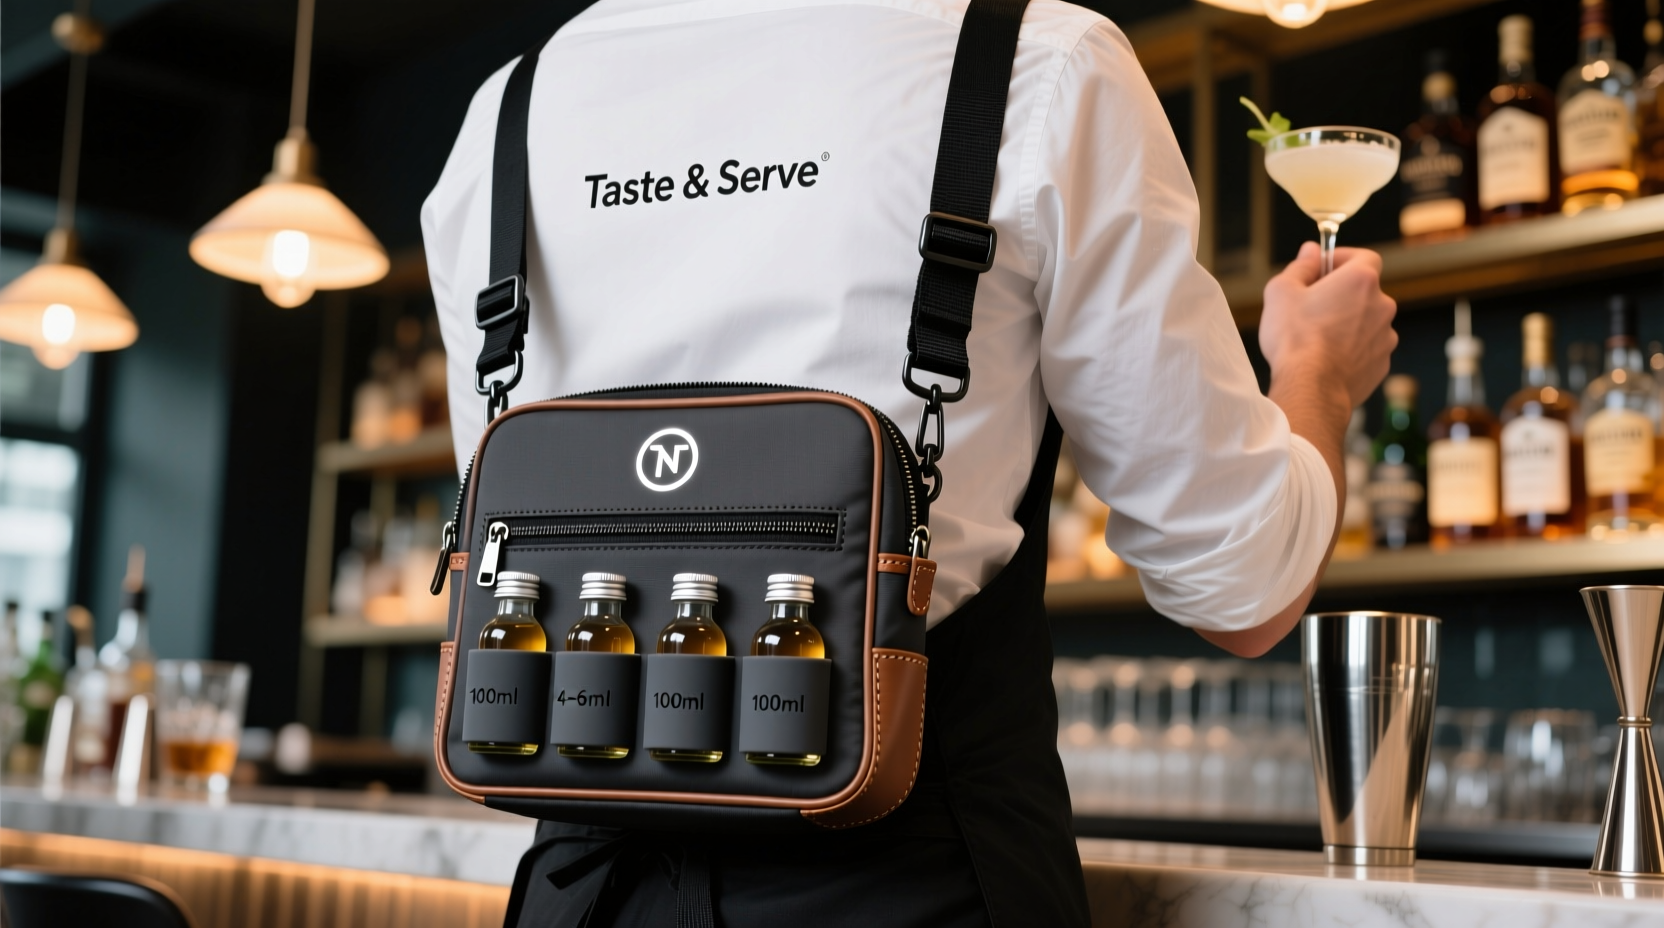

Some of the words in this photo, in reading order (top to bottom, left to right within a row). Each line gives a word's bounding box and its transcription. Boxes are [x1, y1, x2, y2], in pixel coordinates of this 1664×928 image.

[585, 171, 675, 209] Taste
[682, 163, 710, 200] &
[469, 687, 518, 705] 100ml
[653, 692, 704, 710] 100ml
[752, 694, 805, 713] 100ml
